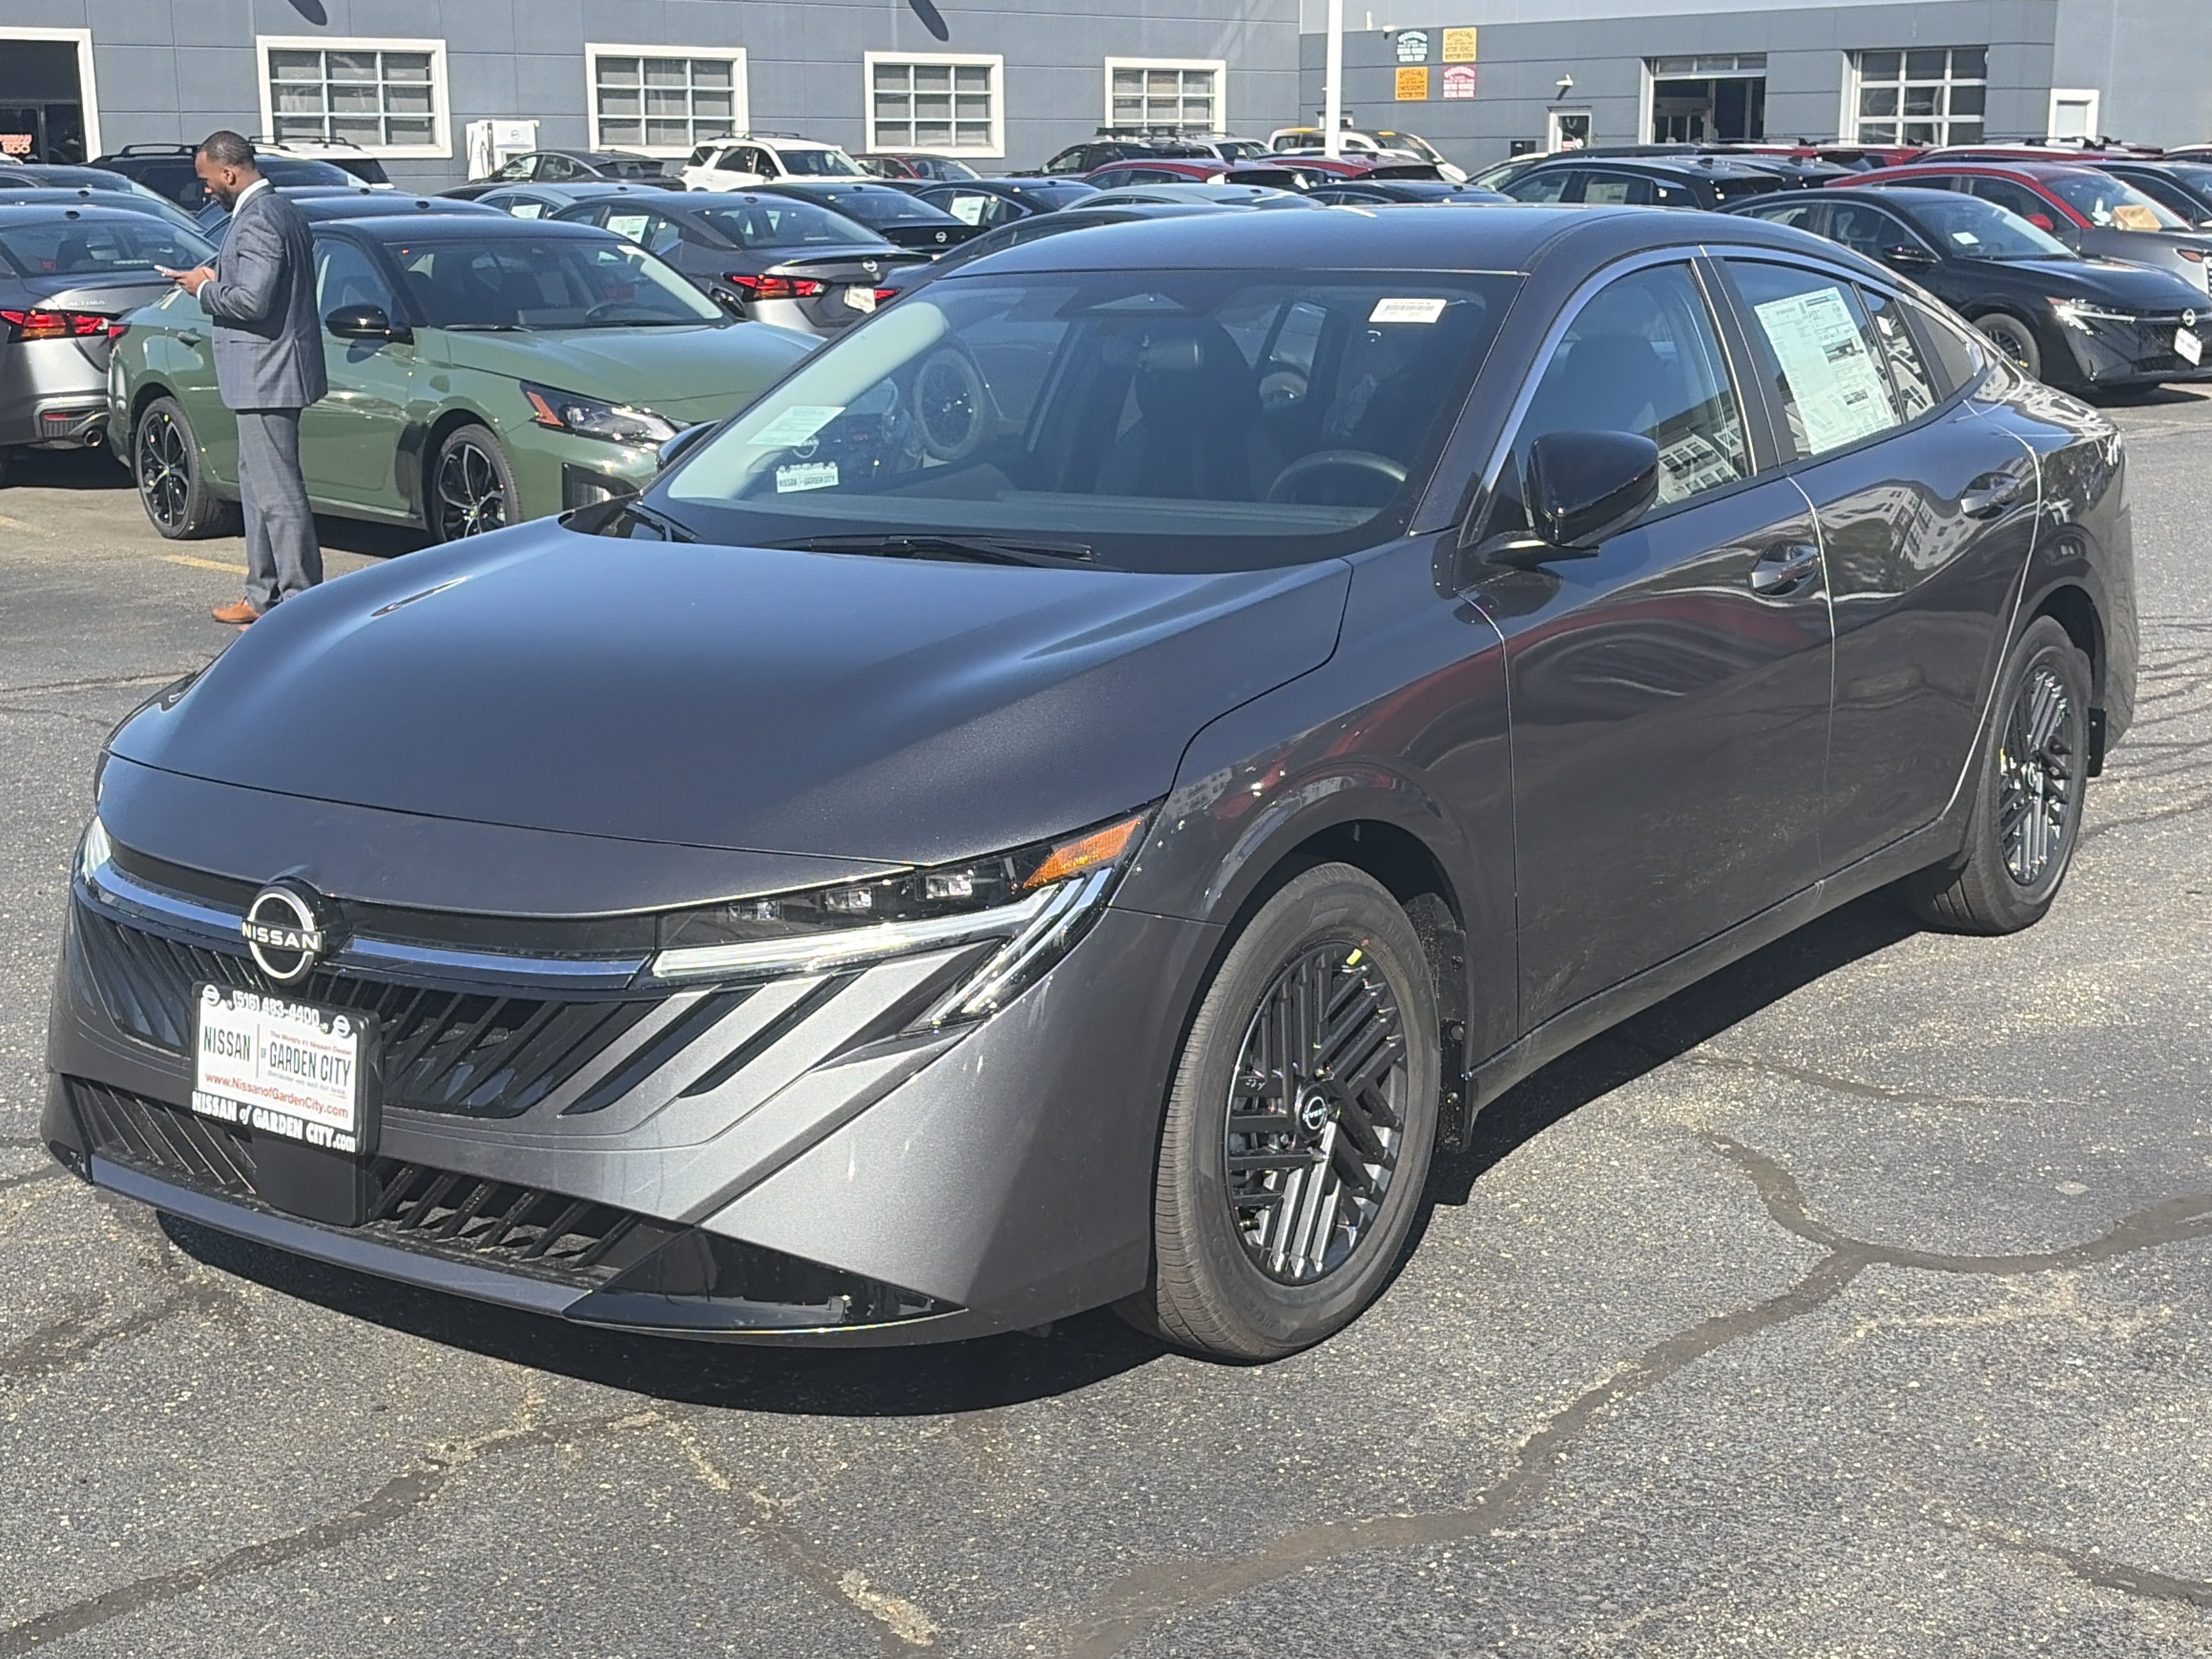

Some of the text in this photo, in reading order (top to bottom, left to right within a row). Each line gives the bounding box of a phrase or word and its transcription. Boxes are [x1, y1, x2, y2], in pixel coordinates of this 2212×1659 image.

[241, 921, 319, 950] NISSAN
[232, 989, 321, 1026] (516) 483-4400
[204, 1026, 251, 1062] NISSAN
[269, 1041, 317, 1079] GARDEN
[320, 1054, 351, 1087] CITY
[192, 1090, 238, 1121] NISSAN
[239, 1105, 252, 1125] of
[252, 1108, 303, 1140] GARDEN
[205, 1073, 349, 1119] www.NissanofGardenCity.com
